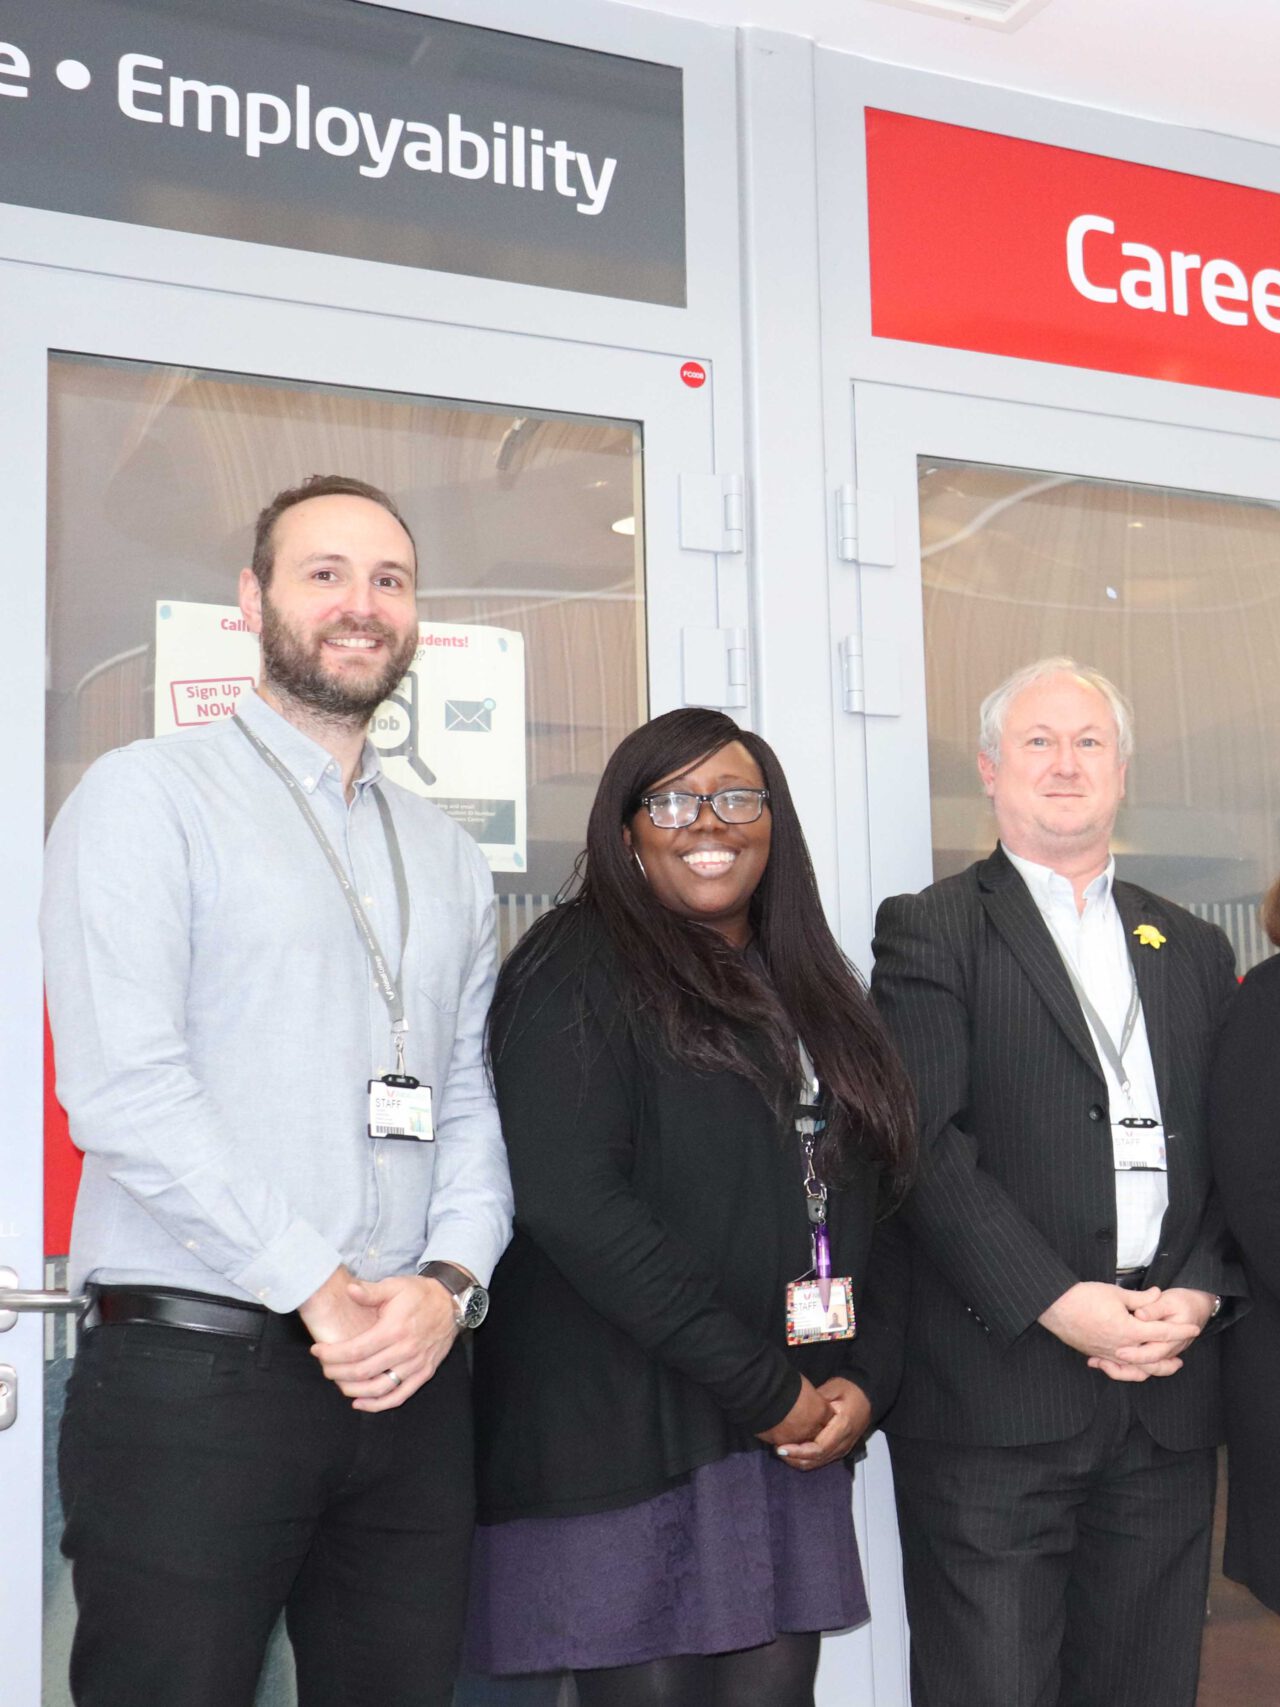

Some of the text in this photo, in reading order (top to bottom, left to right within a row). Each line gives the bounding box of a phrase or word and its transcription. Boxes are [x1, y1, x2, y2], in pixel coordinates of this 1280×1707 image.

[118, 52, 618, 216] Employability
[417, 633, 470, 648] udents!
[186, 684, 241, 701] Sign Up
[196, 702, 236, 717] NOW
[375, 1098, 402, 1109] STAFF
